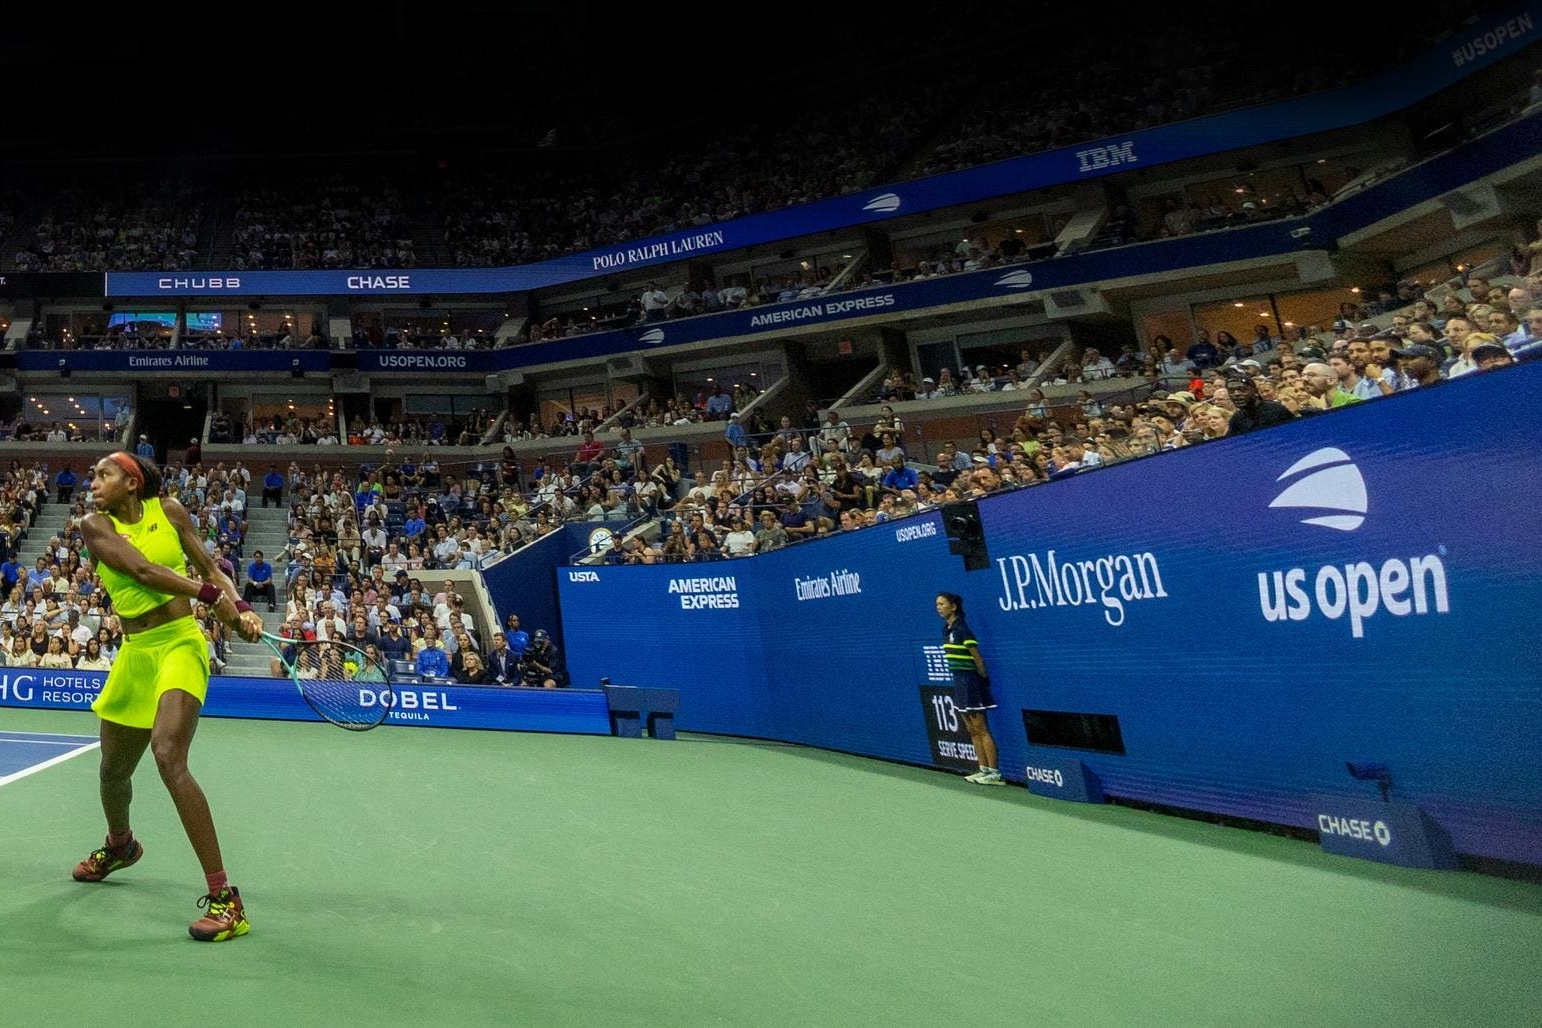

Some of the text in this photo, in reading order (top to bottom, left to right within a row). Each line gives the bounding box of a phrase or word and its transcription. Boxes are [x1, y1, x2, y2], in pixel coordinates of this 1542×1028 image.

[1451, 12, 1534, 67] #USOPEN
[1076, 141, 1138, 172] IBM
[593, 230, 724, 270] POLO RALPH LAUREN
[158, 278, 241, 289] CHUBB
[347, 276, 411, 289] CHASE
[750, 294, 895, 328] AMERICAN EXPRESS
[129, 355, 209, 367] Emirates Airline
[379, 355, 467, 368] USOPEN.ORG
[896, 521, 937, 542] USOPEN.ORG
[568, 571, 600, 582] USTA
[668, 576, 737, 594] AMERICAN
[795, 568, 862, 601] Emirates Airline
[996, 550, 1168, 626] J.P.Morgan
[1258, 554, 1449, 638] us open
[680, 594, 740, 610] EXPRESS
[923, 646, 954, 681] IB
[43, 676, 101, 690] HOTELS
[359, 689, 458, 711] DOBEL
[388, 711, 430, 721] TEQUILA
[932, 695, 958, 733] 113
[938, 740, 959, 759] SERVE
[1026, 766, 1055, 784] CHASE
[1318, 814, 1373, 841] CHASE
